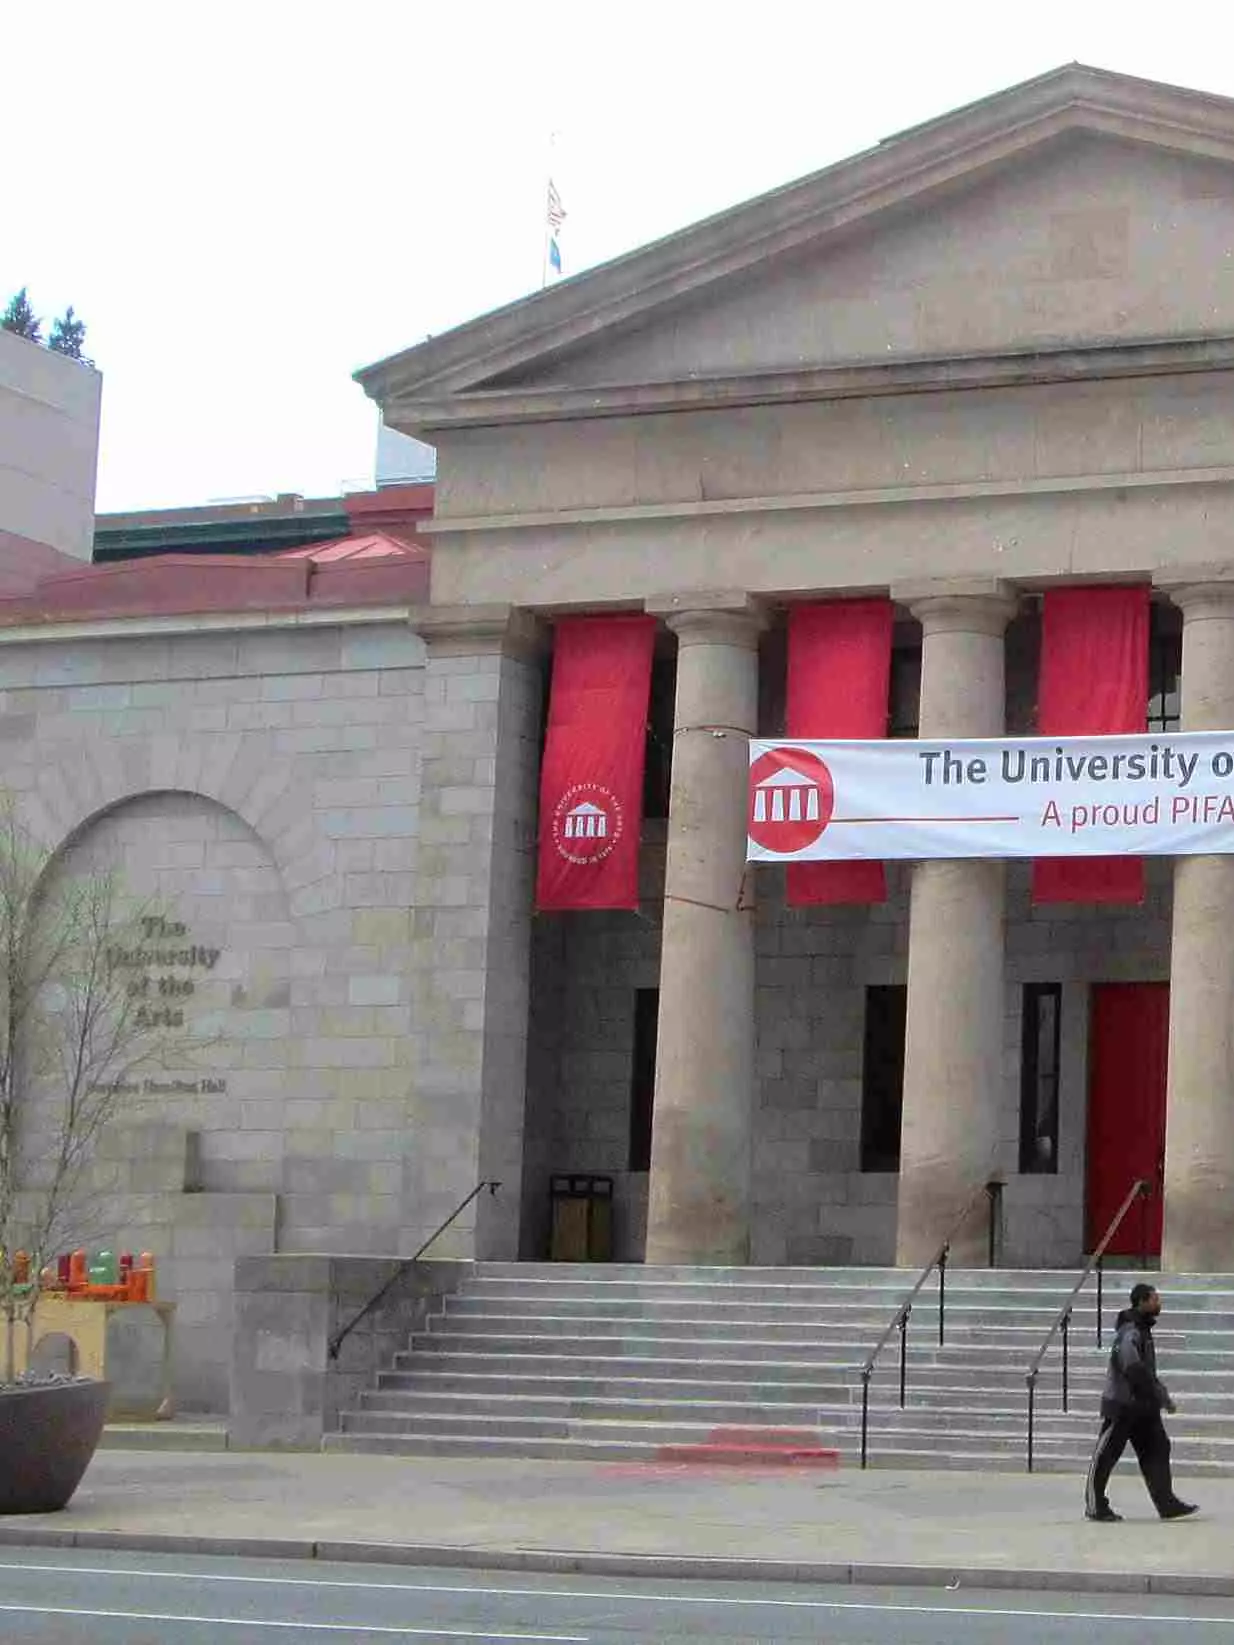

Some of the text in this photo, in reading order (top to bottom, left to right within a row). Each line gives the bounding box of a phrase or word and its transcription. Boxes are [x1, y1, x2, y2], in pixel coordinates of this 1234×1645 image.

[920, 750, 987, 785] The
[1002, 744, 1199, 787] University
[1042, 801, 1061, 827] A
[1072, 796, 1159, 833] proud
